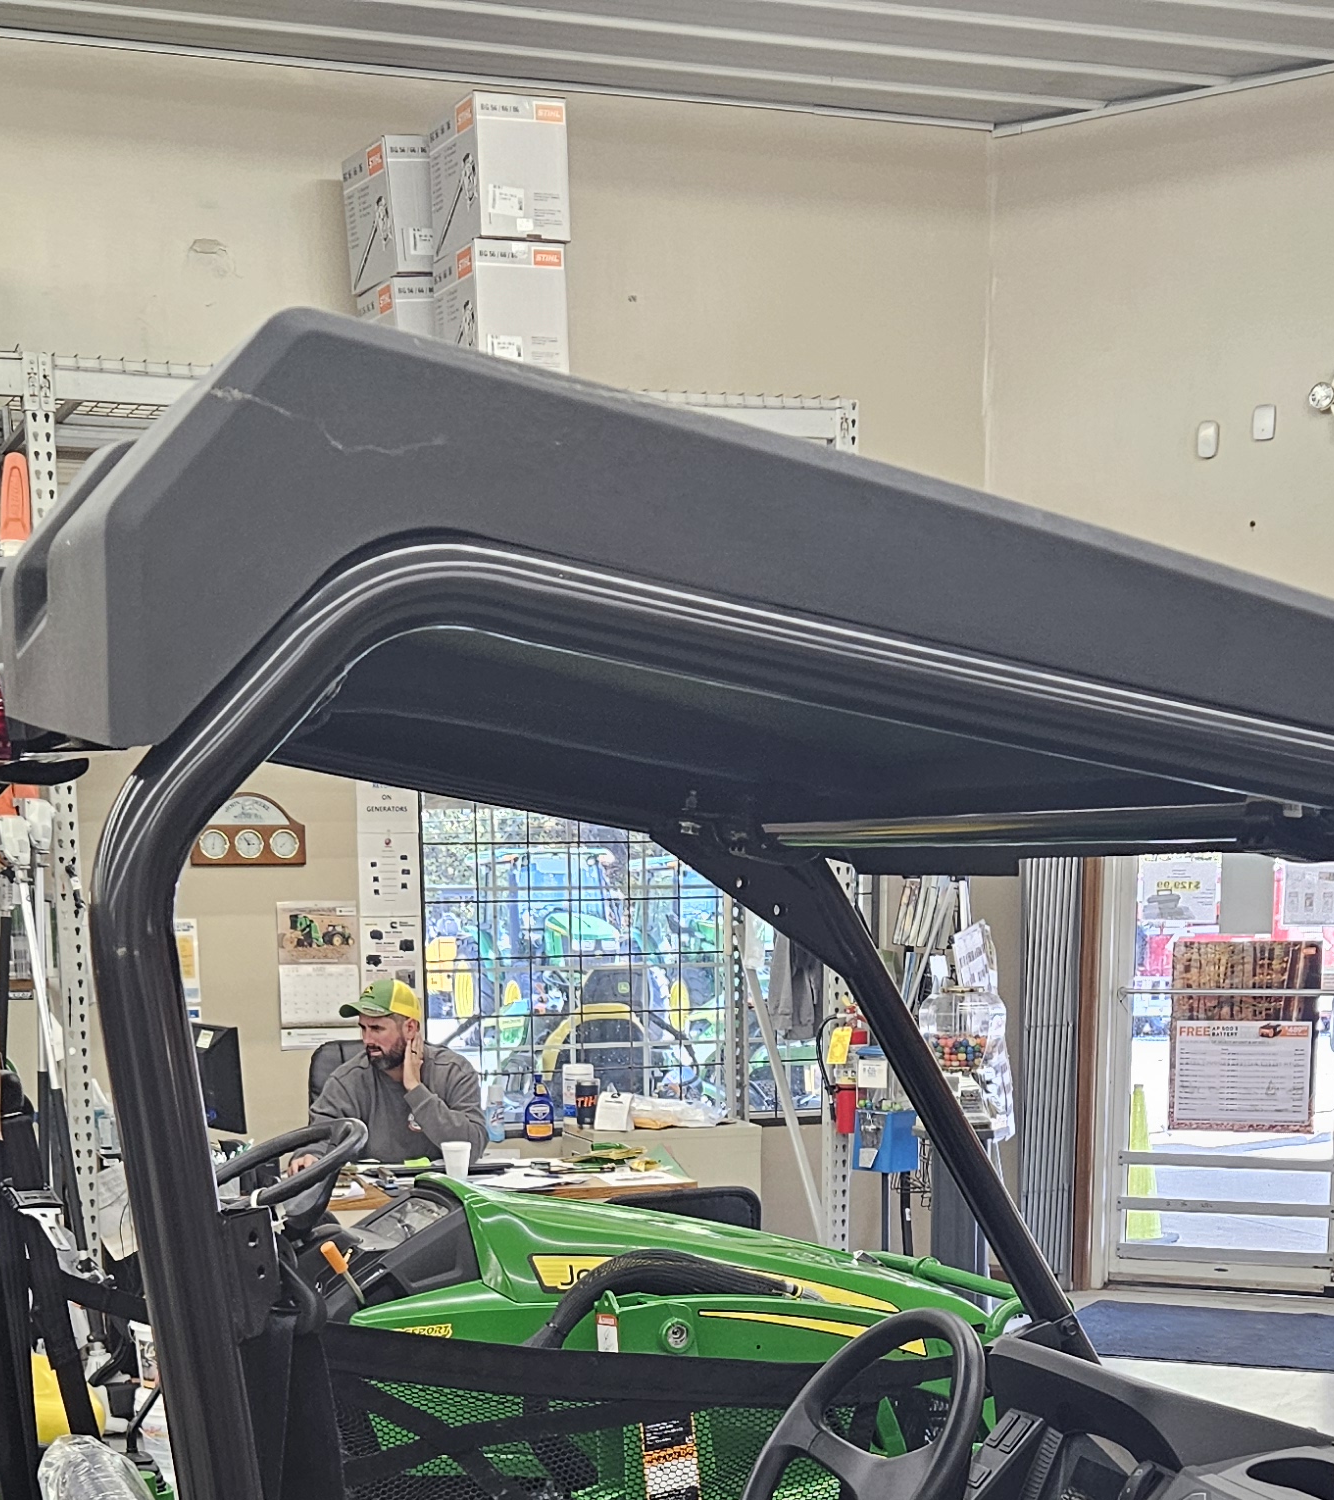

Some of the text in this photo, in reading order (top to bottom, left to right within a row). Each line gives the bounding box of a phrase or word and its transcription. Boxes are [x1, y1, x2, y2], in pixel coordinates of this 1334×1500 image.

[457, 107, 473, 126] STIHL
[537, 108, 561, 118] STIHL
[535, 253, 560, 263] STIHL
[457, 255, 473, 273] STIHL
[366, 805, 408, 813] GENERATORS
[1179, 1026, 1211, 1037] FREE
